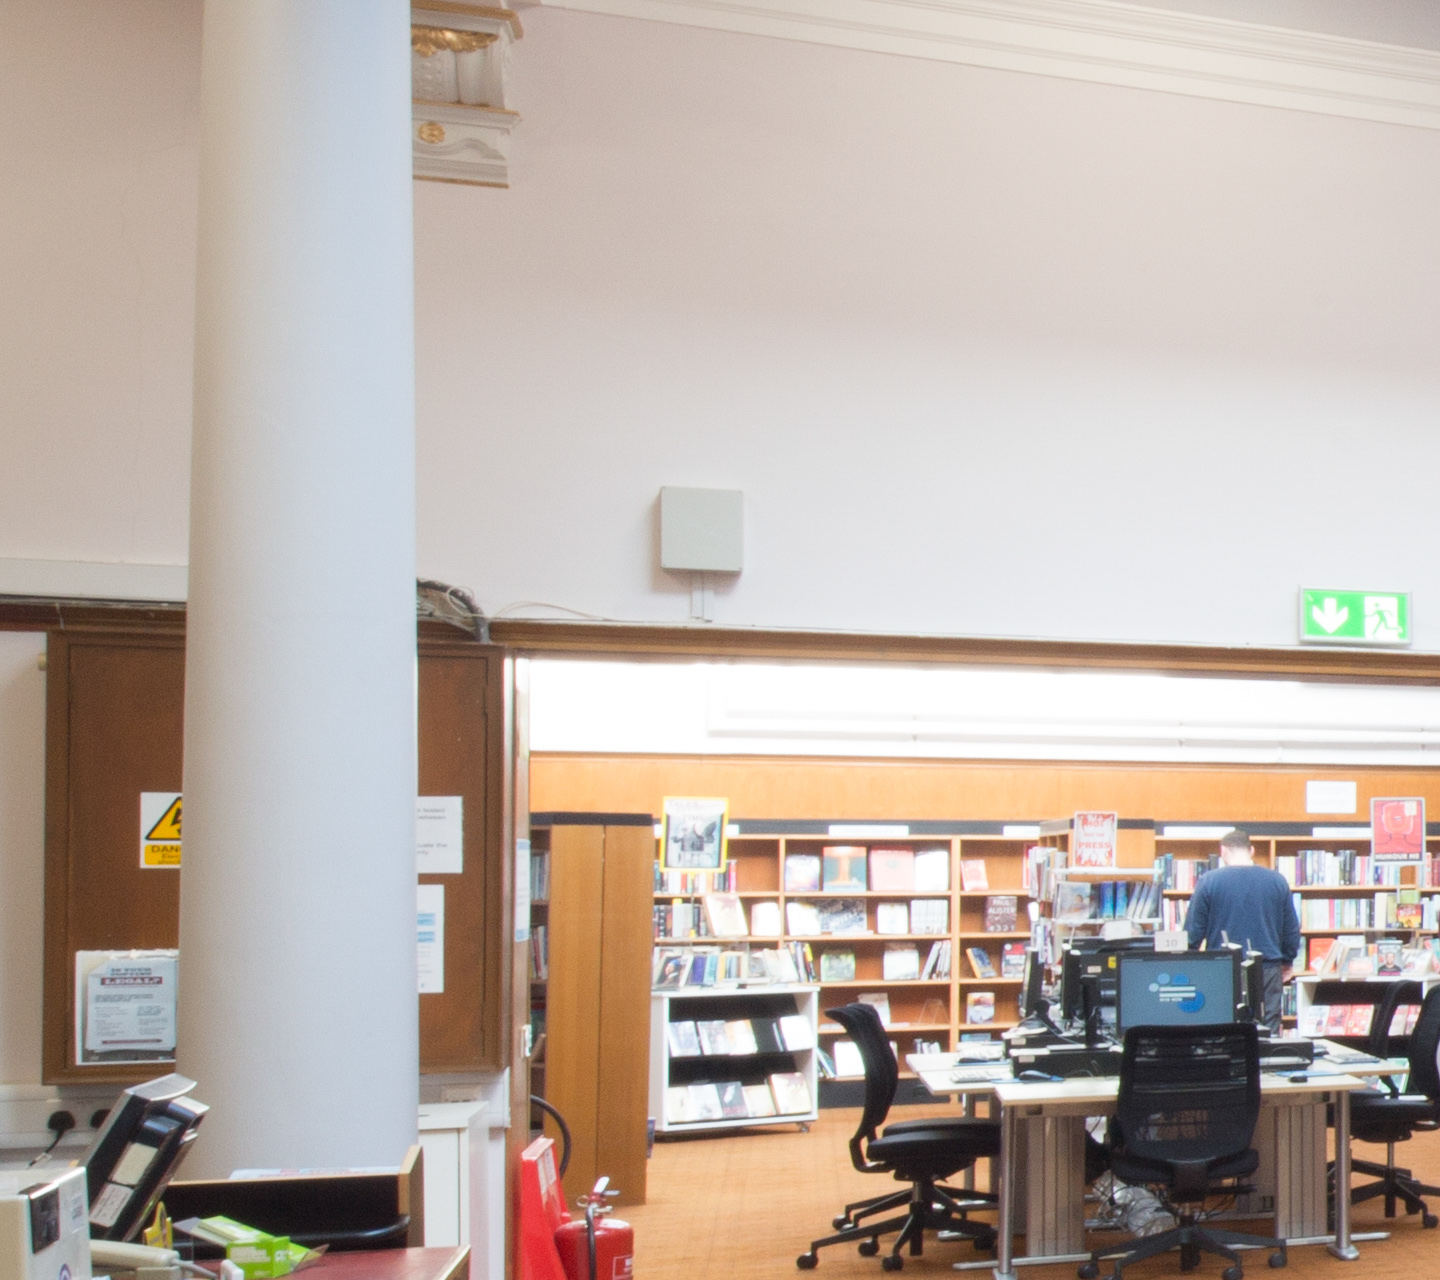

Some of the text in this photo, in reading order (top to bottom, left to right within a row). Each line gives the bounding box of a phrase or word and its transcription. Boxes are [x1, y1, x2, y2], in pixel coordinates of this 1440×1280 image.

[151, 845, 181, 853] DAN
[1078, 841, 1111, 849] PRESS
[992, 898, 1011, 907] PAUL
